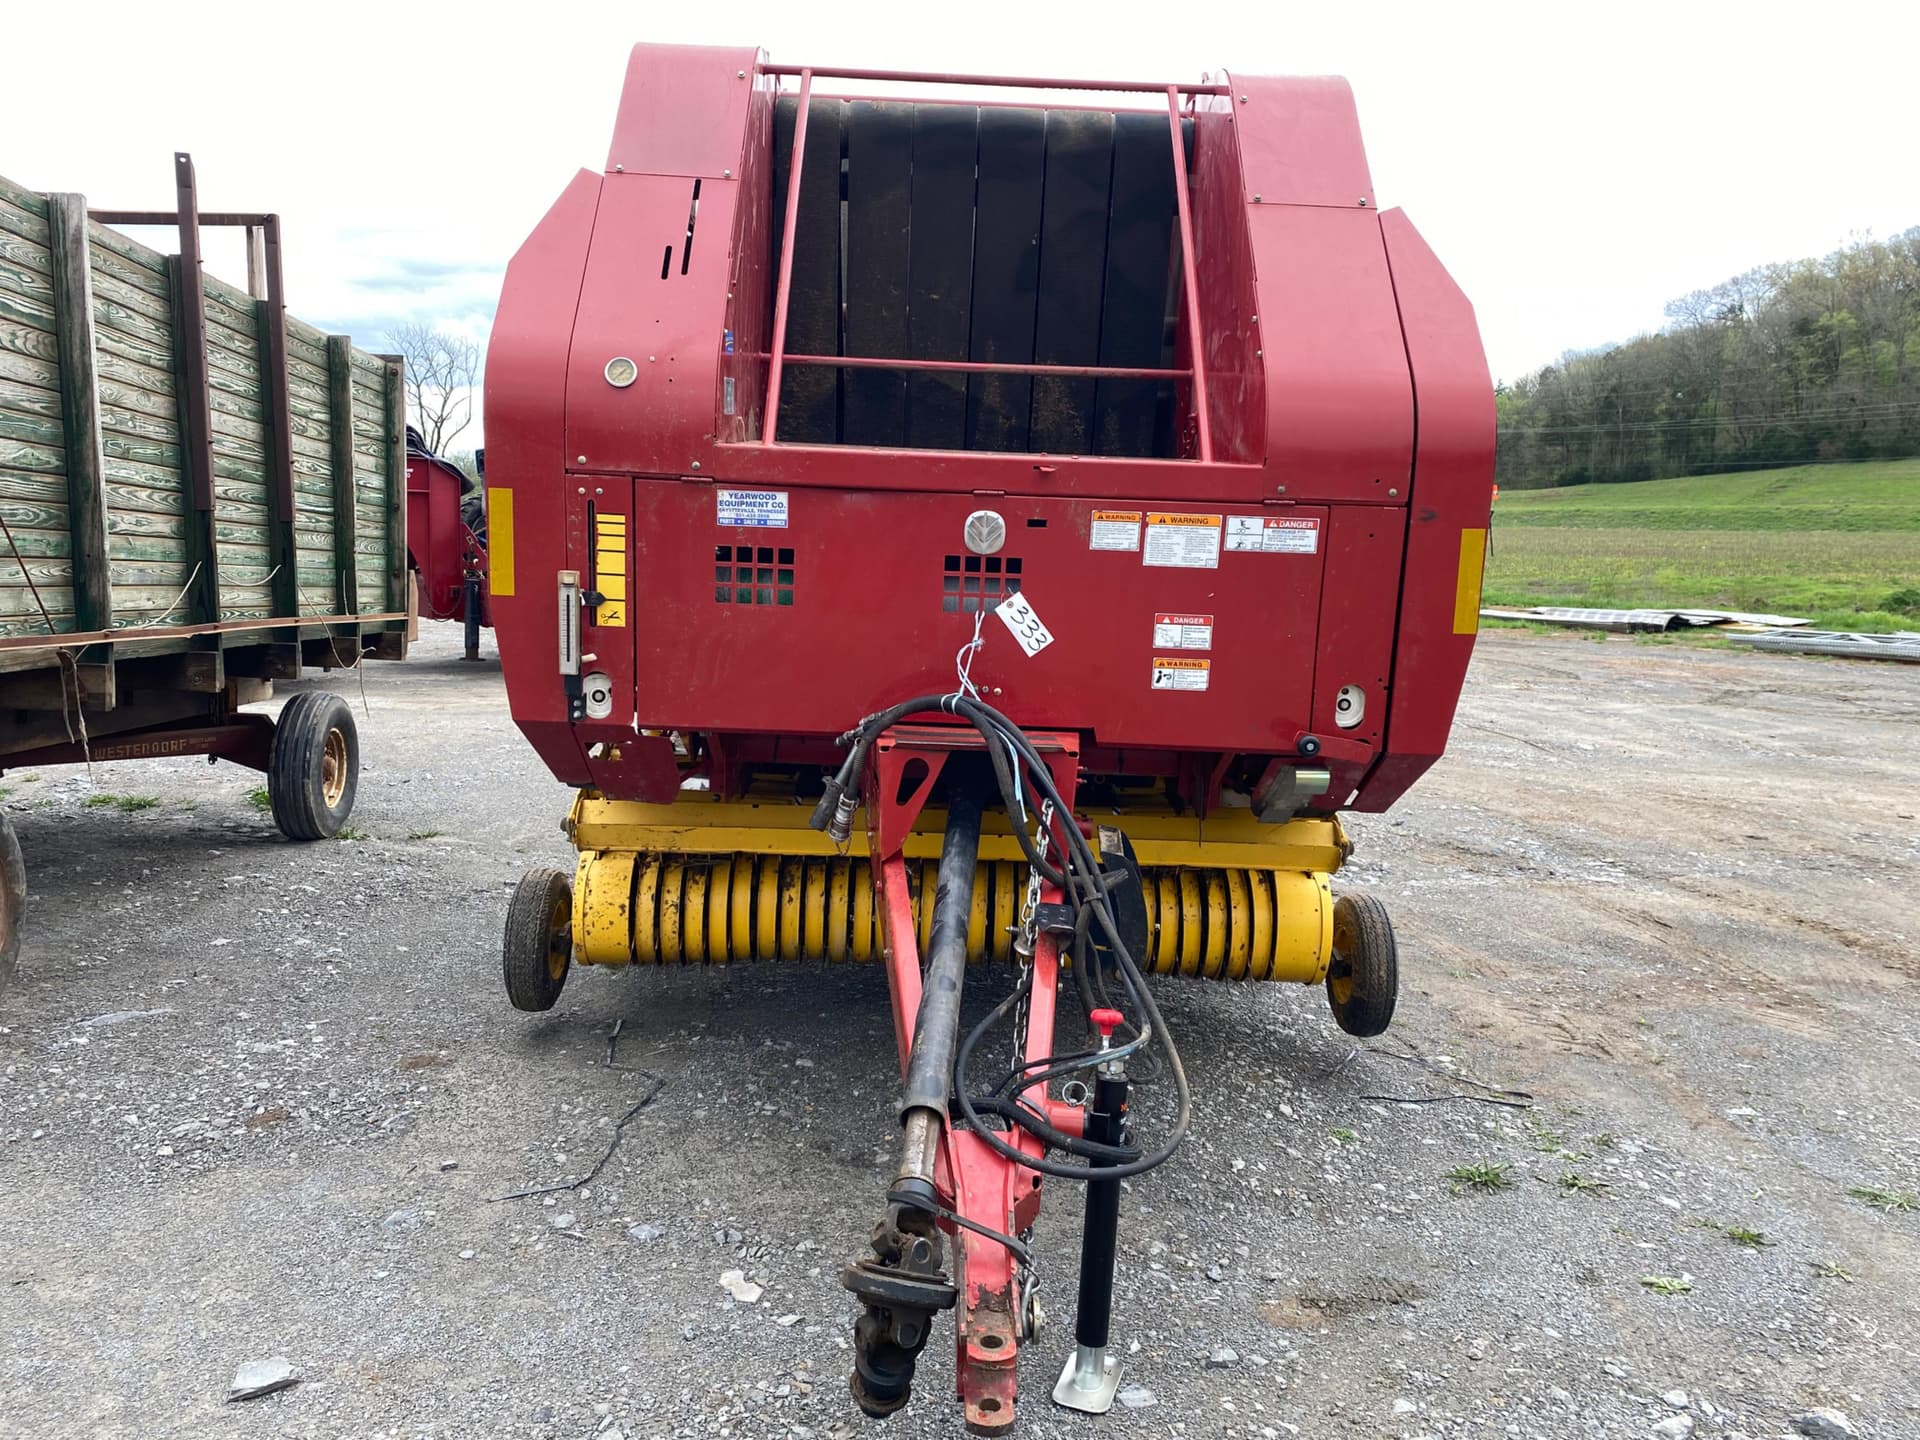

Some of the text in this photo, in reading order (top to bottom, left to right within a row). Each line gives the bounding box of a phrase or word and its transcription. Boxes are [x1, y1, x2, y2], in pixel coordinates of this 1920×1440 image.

[728, 492, 777, 500] YEARWOOD
[719, 500, 786, 509] EQUIPMENT CO.
[1170, 516, 1209, 525] WARNING
[1279, 520, 1314, 528] DANGER
[1173, 616, 1205, 625] DANGER
[1010, 606, 1048, 651] 333
[94, 739, 187, 759] WESTENDORF
